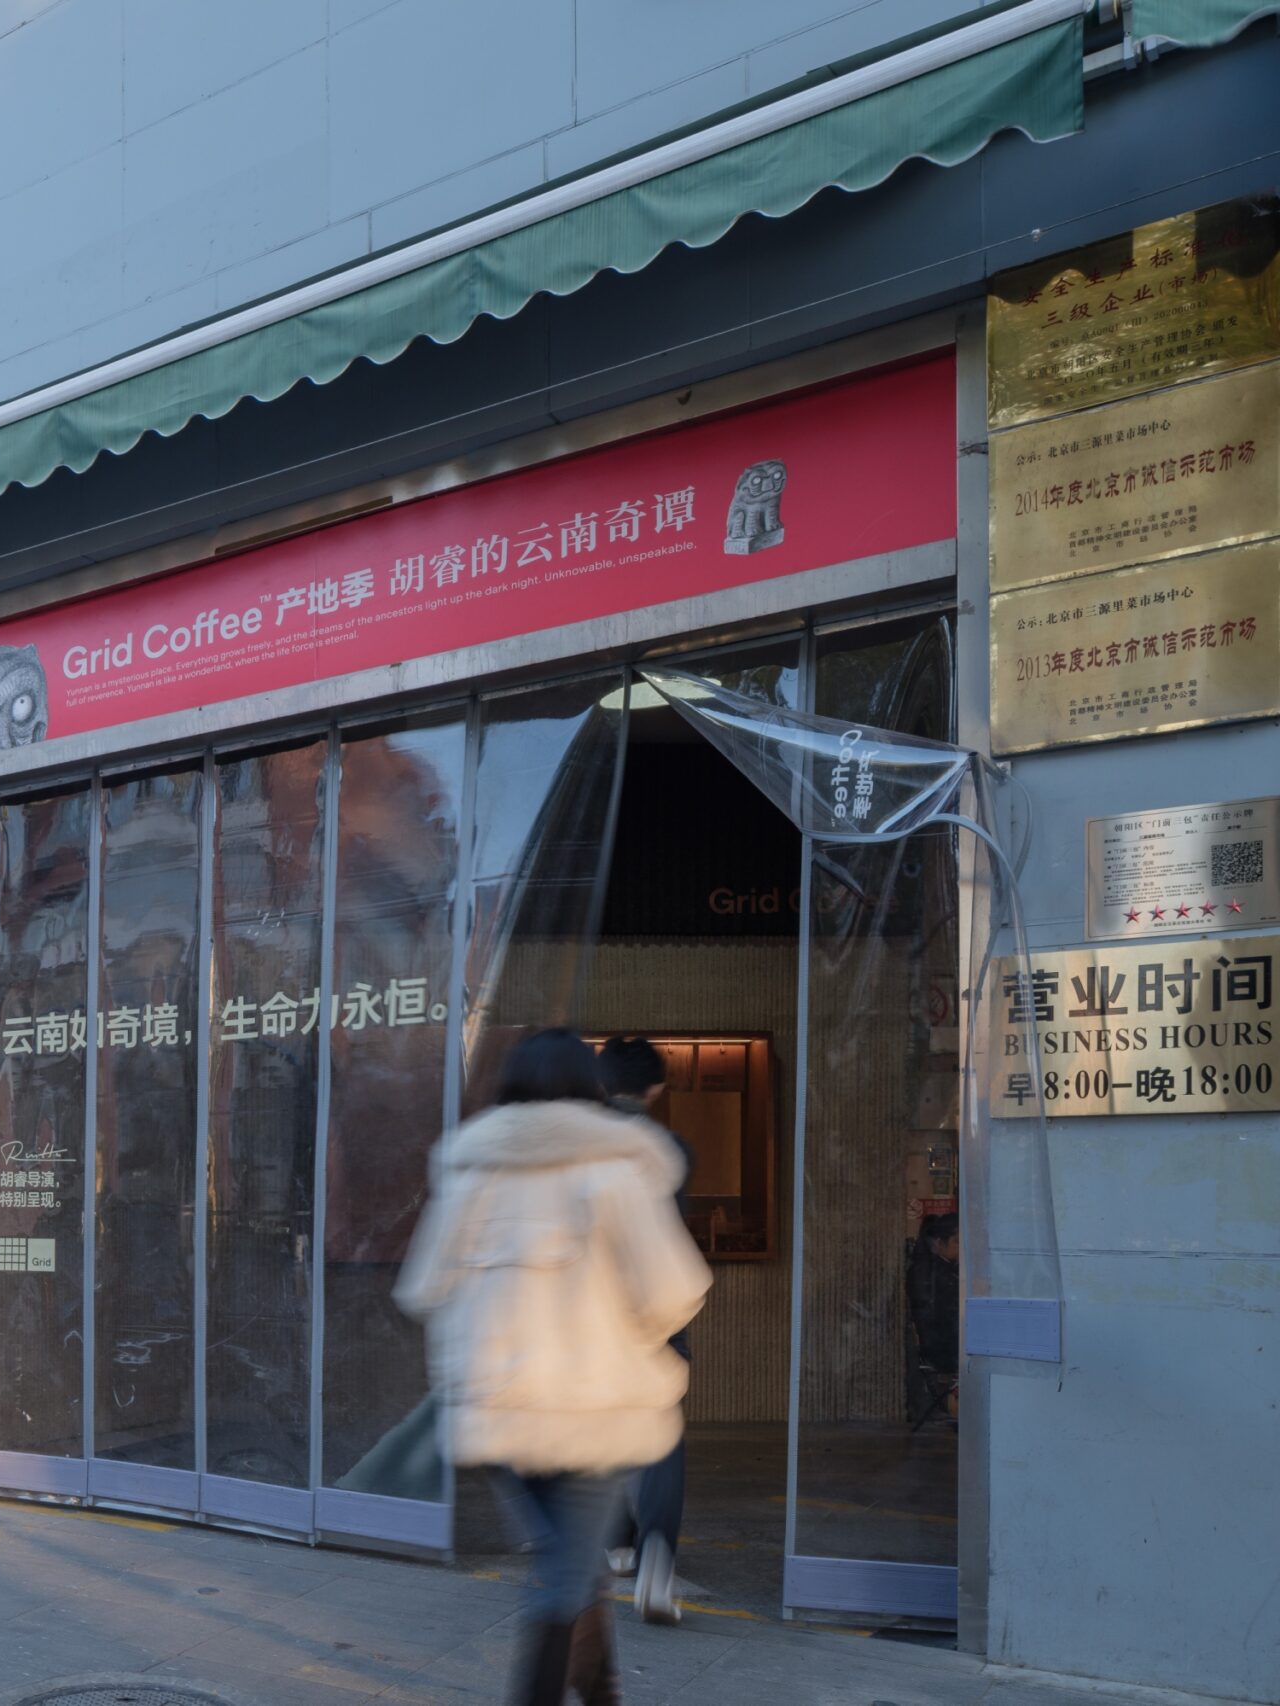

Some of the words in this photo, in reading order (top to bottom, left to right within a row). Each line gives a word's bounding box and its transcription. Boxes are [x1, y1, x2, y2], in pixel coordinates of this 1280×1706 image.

[1015, 440, 1256, 517] 2014年度北京市诚信示范市场
[63, 633, 132, 680] Grid
[275, 568, 375, 626] 产地季
[389, 486, 696, 597] 胡睿的云南奇谭
[66, 684, 93, 698] Yunnan
[108, 671, 149, 690] mysterious
[176, 653, 219, 673] Everything
[220, 648, 246, 662] grows
[275, 634, 292, 646] and
[293, 630, 308, 641] the
[310, 623, 343, 637] dreams
[357, 615, 372, 626] the
[375, 604, 423, 622] ancestors
[425, 596, 448, 611] light
[465, 588, 483, 600] the
[484, 581, 509, 596] dark
[1017, 617, 1257, 682] 2013年度北京市诚信示范市场
[66, 697, 78, 707] full
[127, 680, 155, 693] Yunnan
[164, 674, 177, 684] like
[235, 656, 260, 669] where
[261, 651, 275, 662] the
[277, 646, 290, 658] life
[291, 641, 315, 655] force
[708, 886, 780, 914] Grid
[1002, 955, 1273, 1024] 营业时间
[1004, 1026, 1149, 1057] BUSINESS
[1158, 1020, 1273, 1049] HOURS
[31, 1257, 52, 1267] Grid
